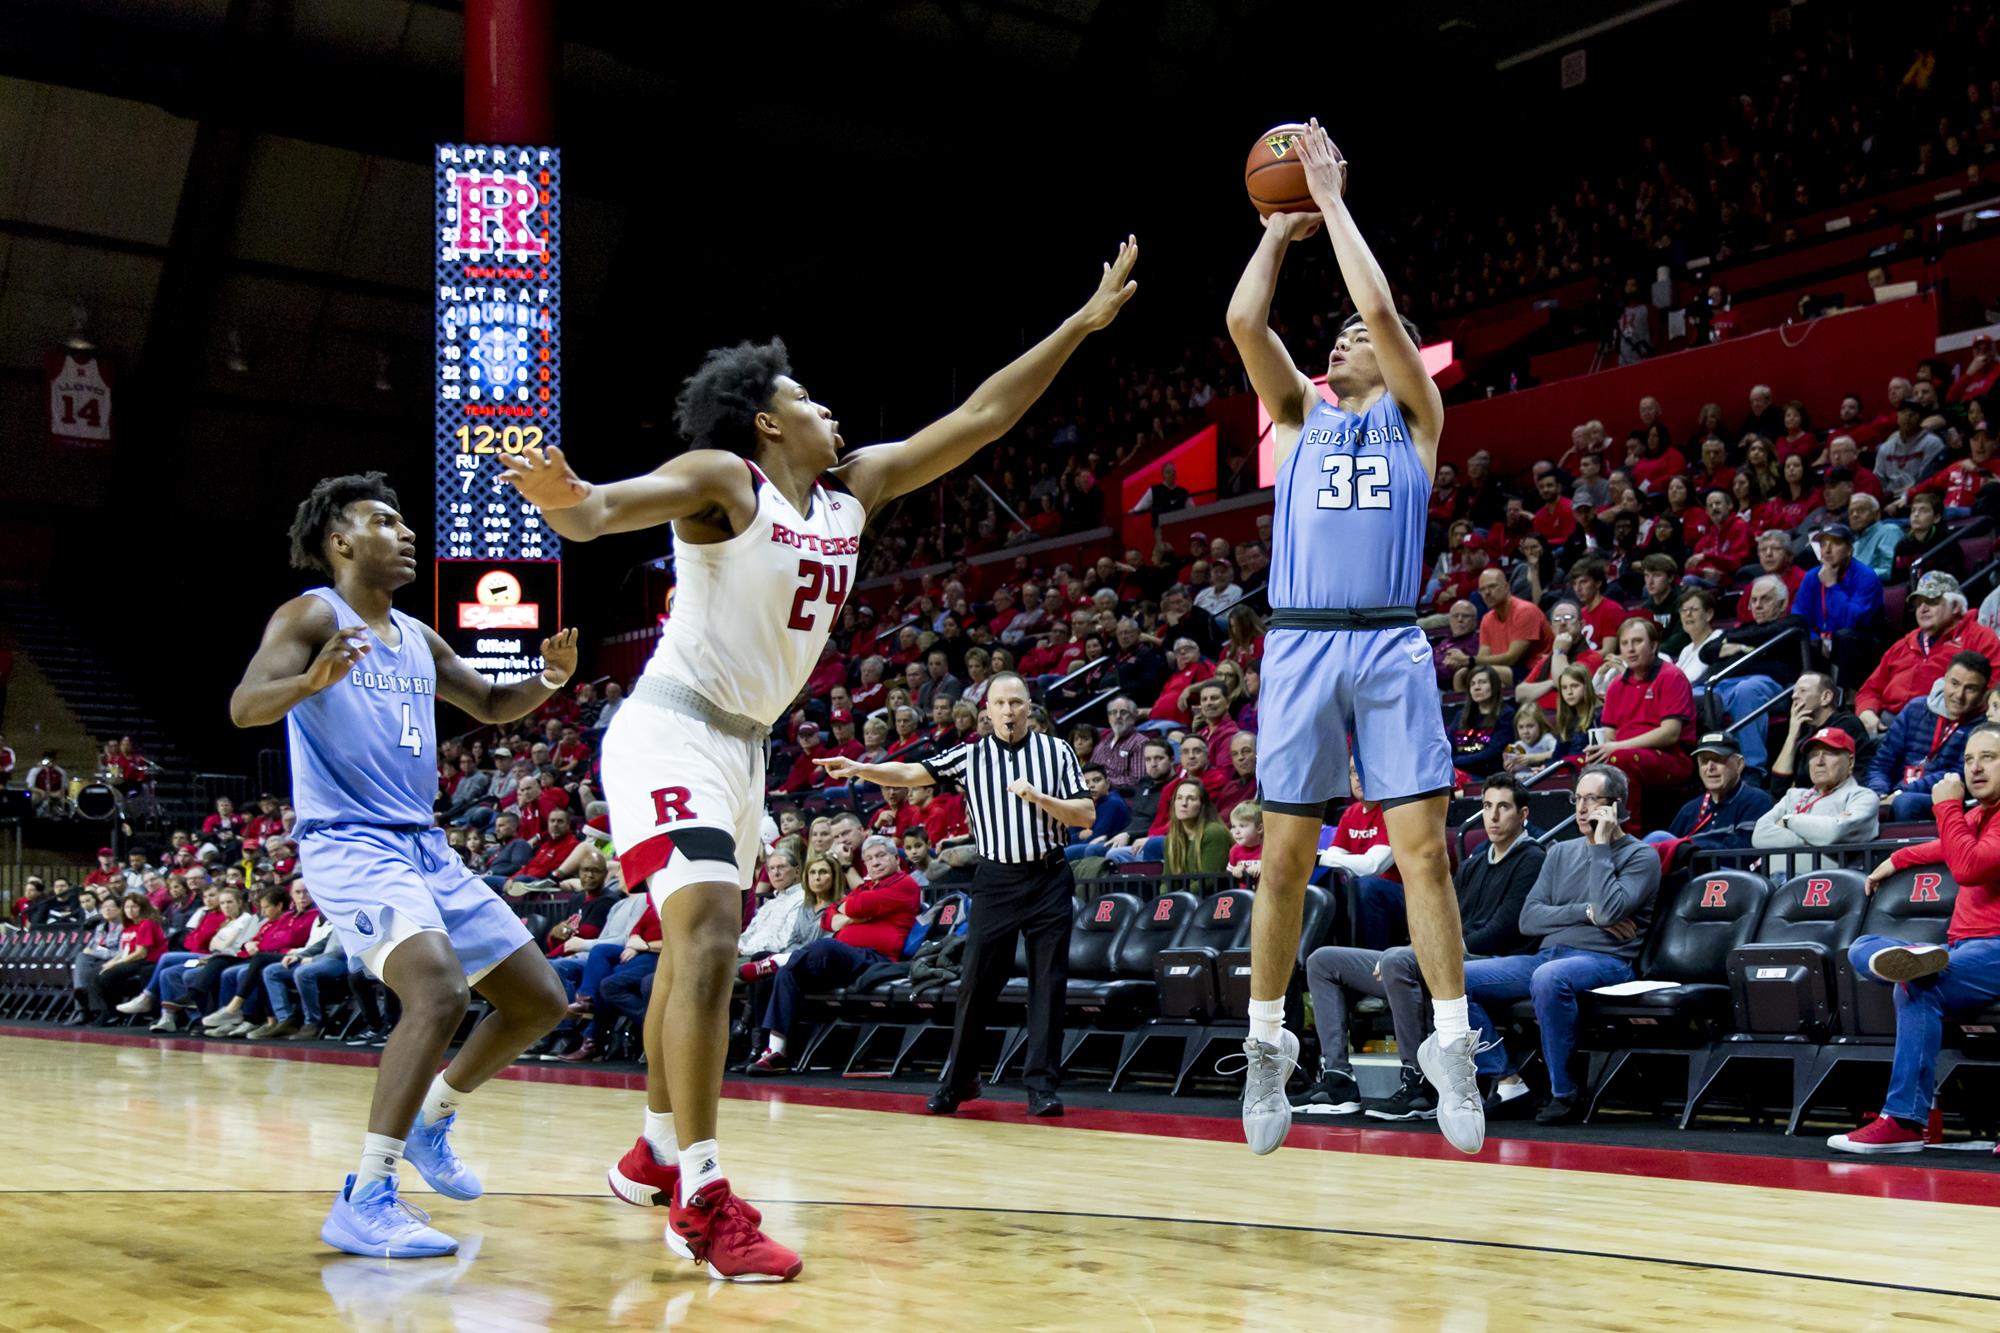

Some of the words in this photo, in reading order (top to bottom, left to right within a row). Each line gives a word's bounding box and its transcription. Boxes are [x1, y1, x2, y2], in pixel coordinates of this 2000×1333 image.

[441, 148, 461, 163] PL
[465, 149, 486, 164] PT
[494, 150, 506, 164] R
[519, 151, 530, 165] A
[539, 151, 550, 165] F
[441, 287, 461, 301] PL
[465, 287, 486, 301] PT
[494, 288, 506, 302] R
[519, 288, 530, 302] A
[538, 289, 548, 303] F
[443, 346, 460, 360] 10
[442, 365, 460, 379] 22
[442, 385, 460, 399] 32
[62, 395, 102, 428] 14
[456, 425, 543, 454] 12:02
[456, 455, 479, 469] RU
[459, 471, 475, 494] 7
[1317, 453, 1391, 510] 32
[488, 547, 505, 557] FT
[787, 559, 848, 633] 24
[399, 703, 422, 757] 4
[651, 786, 698, 827] R
[1701, 880, 1729, 907] R
[1802, 879, 1832, 906] R
[1910, 873, 1942, 902] R
[1095, 901, 1115, 921] R
[1154, 899, 1173, 920] R
[1213, 897, 1233, 919] R
